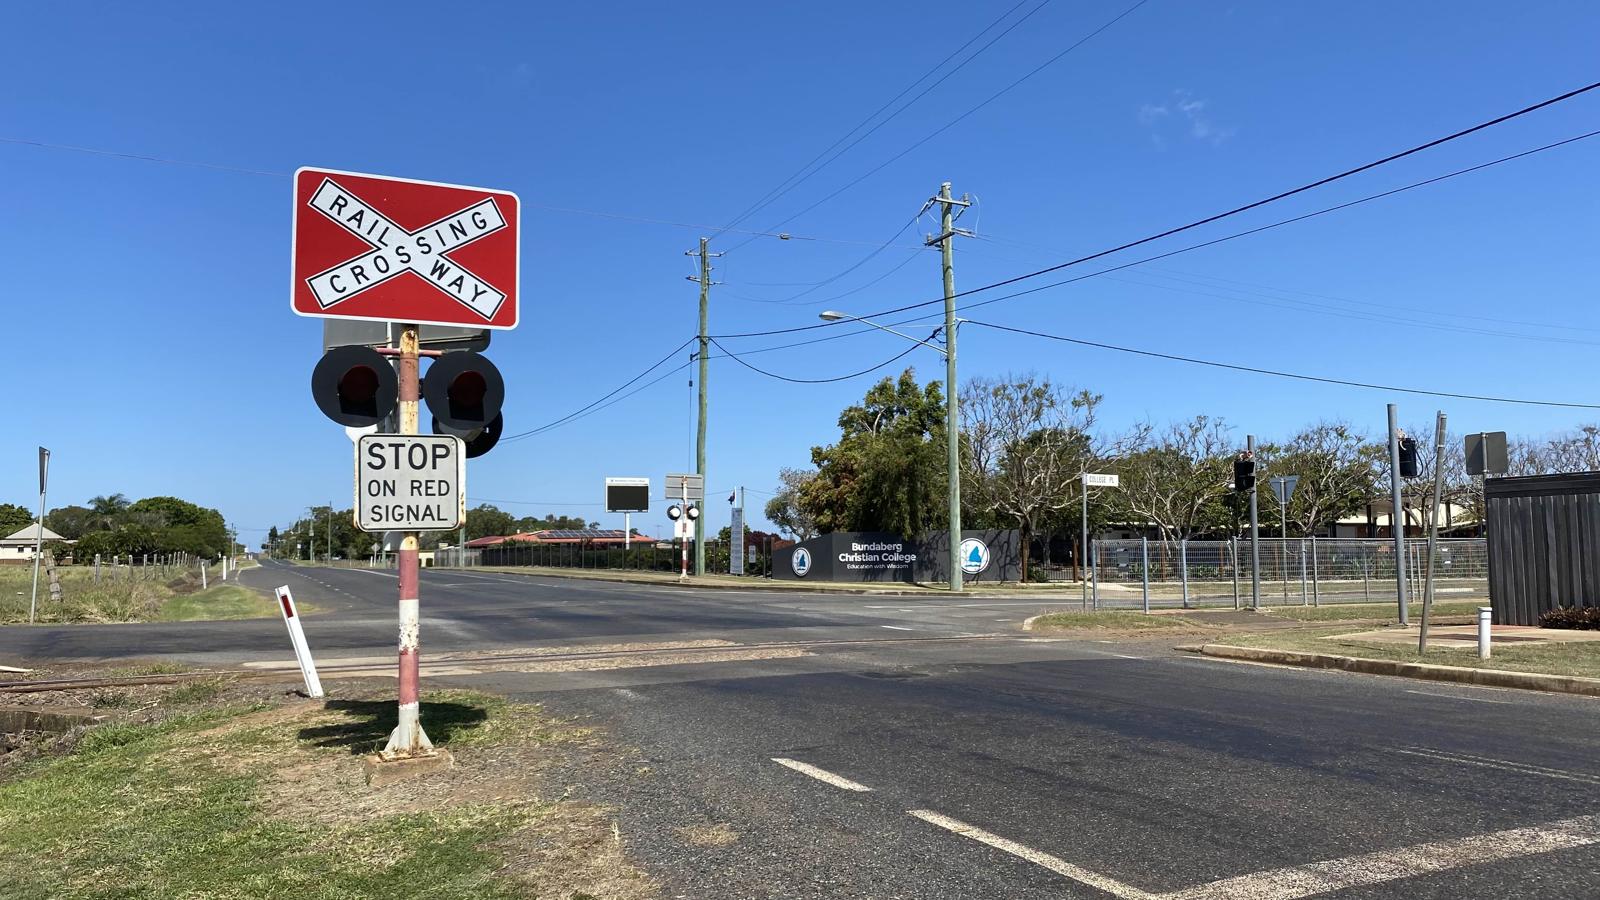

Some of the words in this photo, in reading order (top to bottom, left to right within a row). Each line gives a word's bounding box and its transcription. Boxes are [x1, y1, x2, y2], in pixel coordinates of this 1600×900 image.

[328, 194, 389, 247] RAIL
[429, 259, 488, 303] WAY
[329, 211, 487, 294] CROSSING
[367, 443, 450, 470] STOP
[368, 479, 395, 497] ON
[410, 480, 450, 496] RED
[1089, 475, 1106, 483] COLLEGE
[370, 504, 448, 522] SIGNAL
[851, 542, 902, 552] Bundaberg
[838, 552, 879, 562] Christian
[881, 552, 916, 563] College
